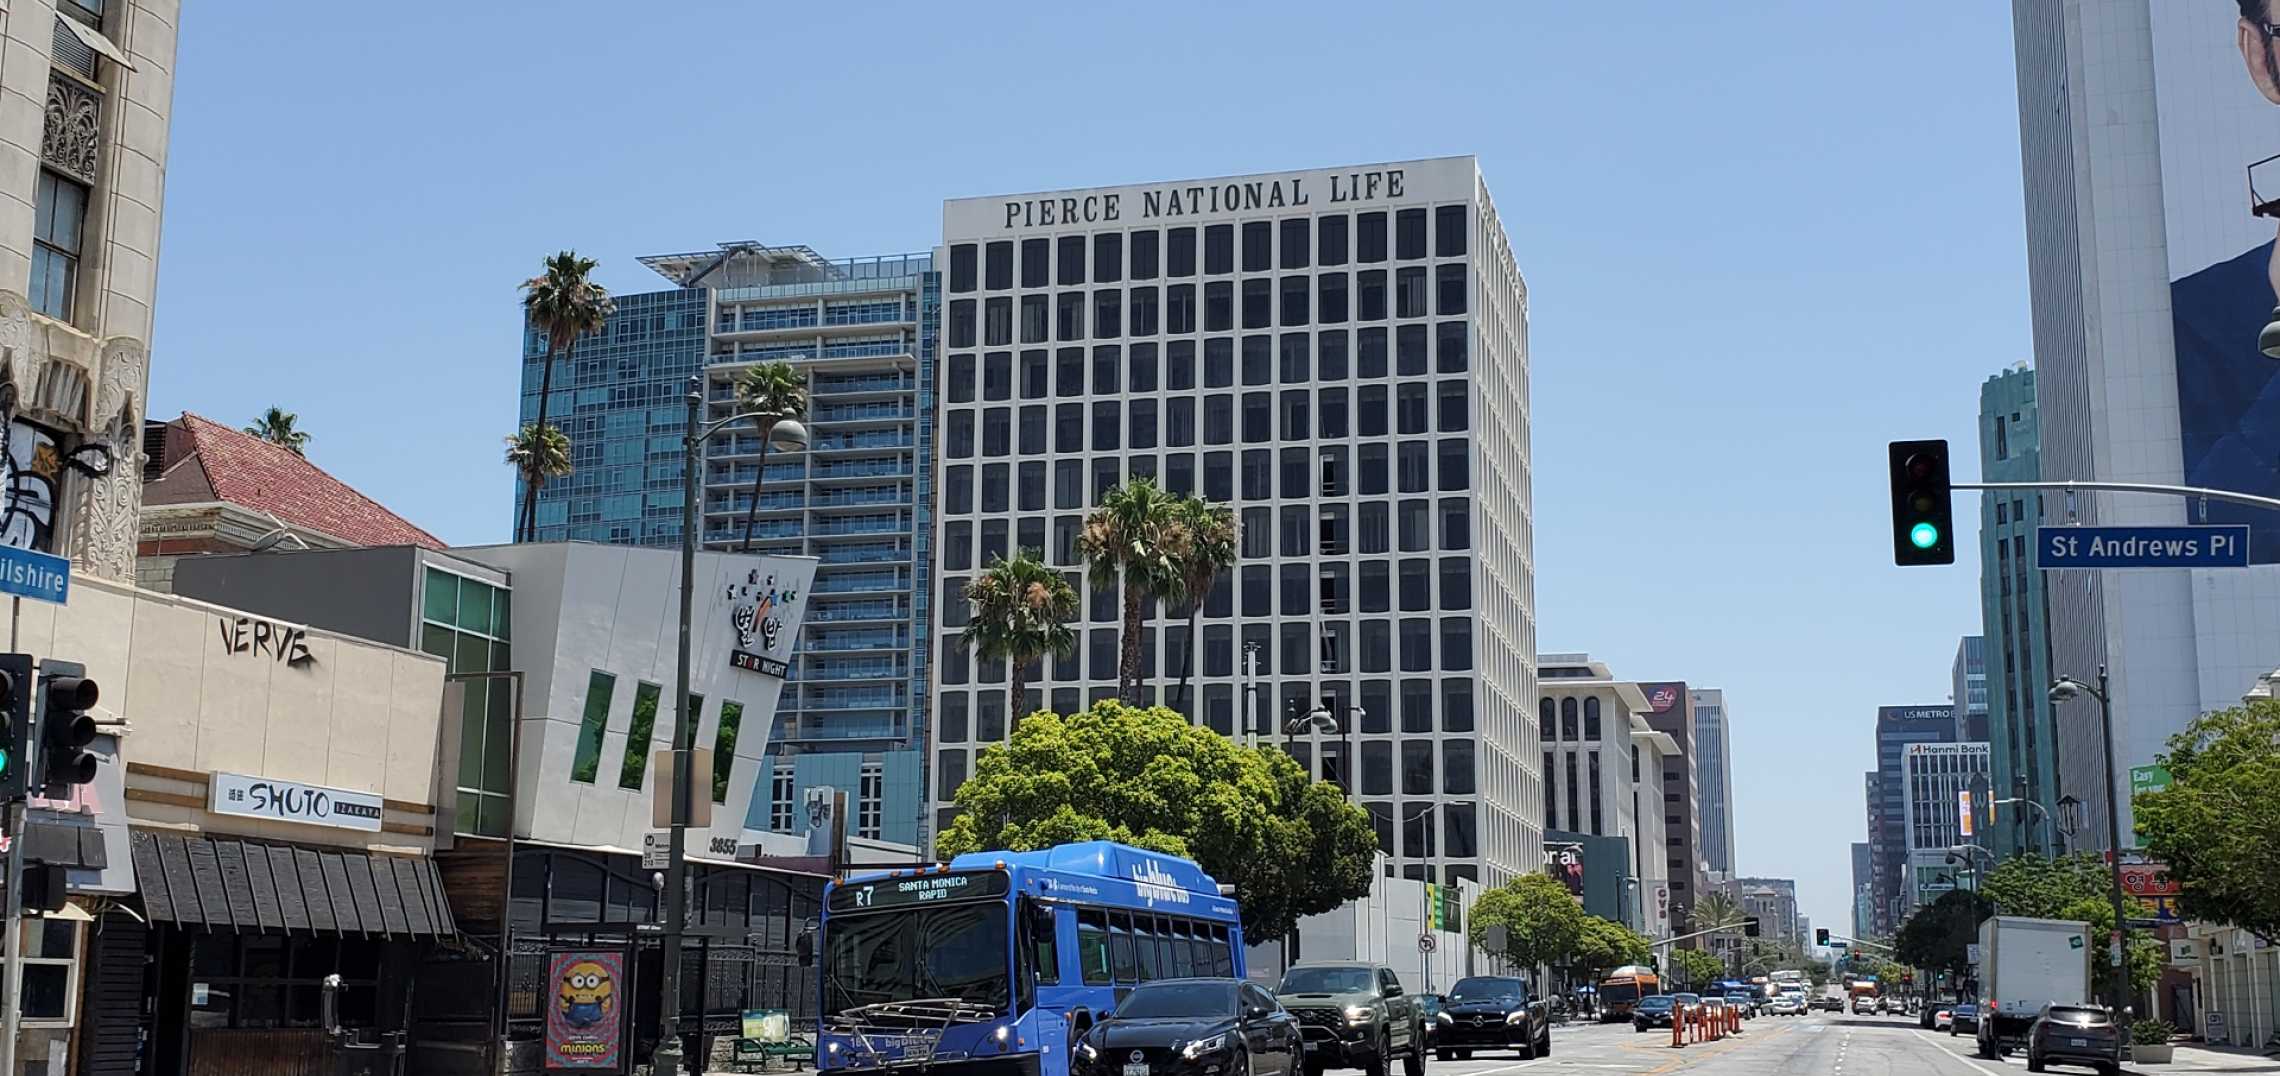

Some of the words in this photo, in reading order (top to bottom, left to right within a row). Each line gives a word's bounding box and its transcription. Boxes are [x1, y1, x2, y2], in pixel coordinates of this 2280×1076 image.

[1004, 194, 1121, 228] PIERCE
[1142, 179, 1310, 218] NATIONAL
[1328, 170, 1406, 202] LIFE
[2051, 535, 2079, 558] St
[2088, 535, 2199, 558] Andrews
[2209, 534, 2235, 557] Pl
[0, 557, 64, 593] ilshire
[762, 660, 786, 676] NIGHT
[1653, 690, 1675, 705] 24
[1923, 744, 1959, 754] Hanmi
[1961, 744, 1989, 753] Bank
[250, 783, 330, 818] SHUTO
[709, 837, 738, 855] 3855
[898, 880, 930, 892] SANTA
[931, 876, 967, 889] MONICA
[918, 888, 947, 901] RAPID
[1657, 888, 1667, 919] CVS
